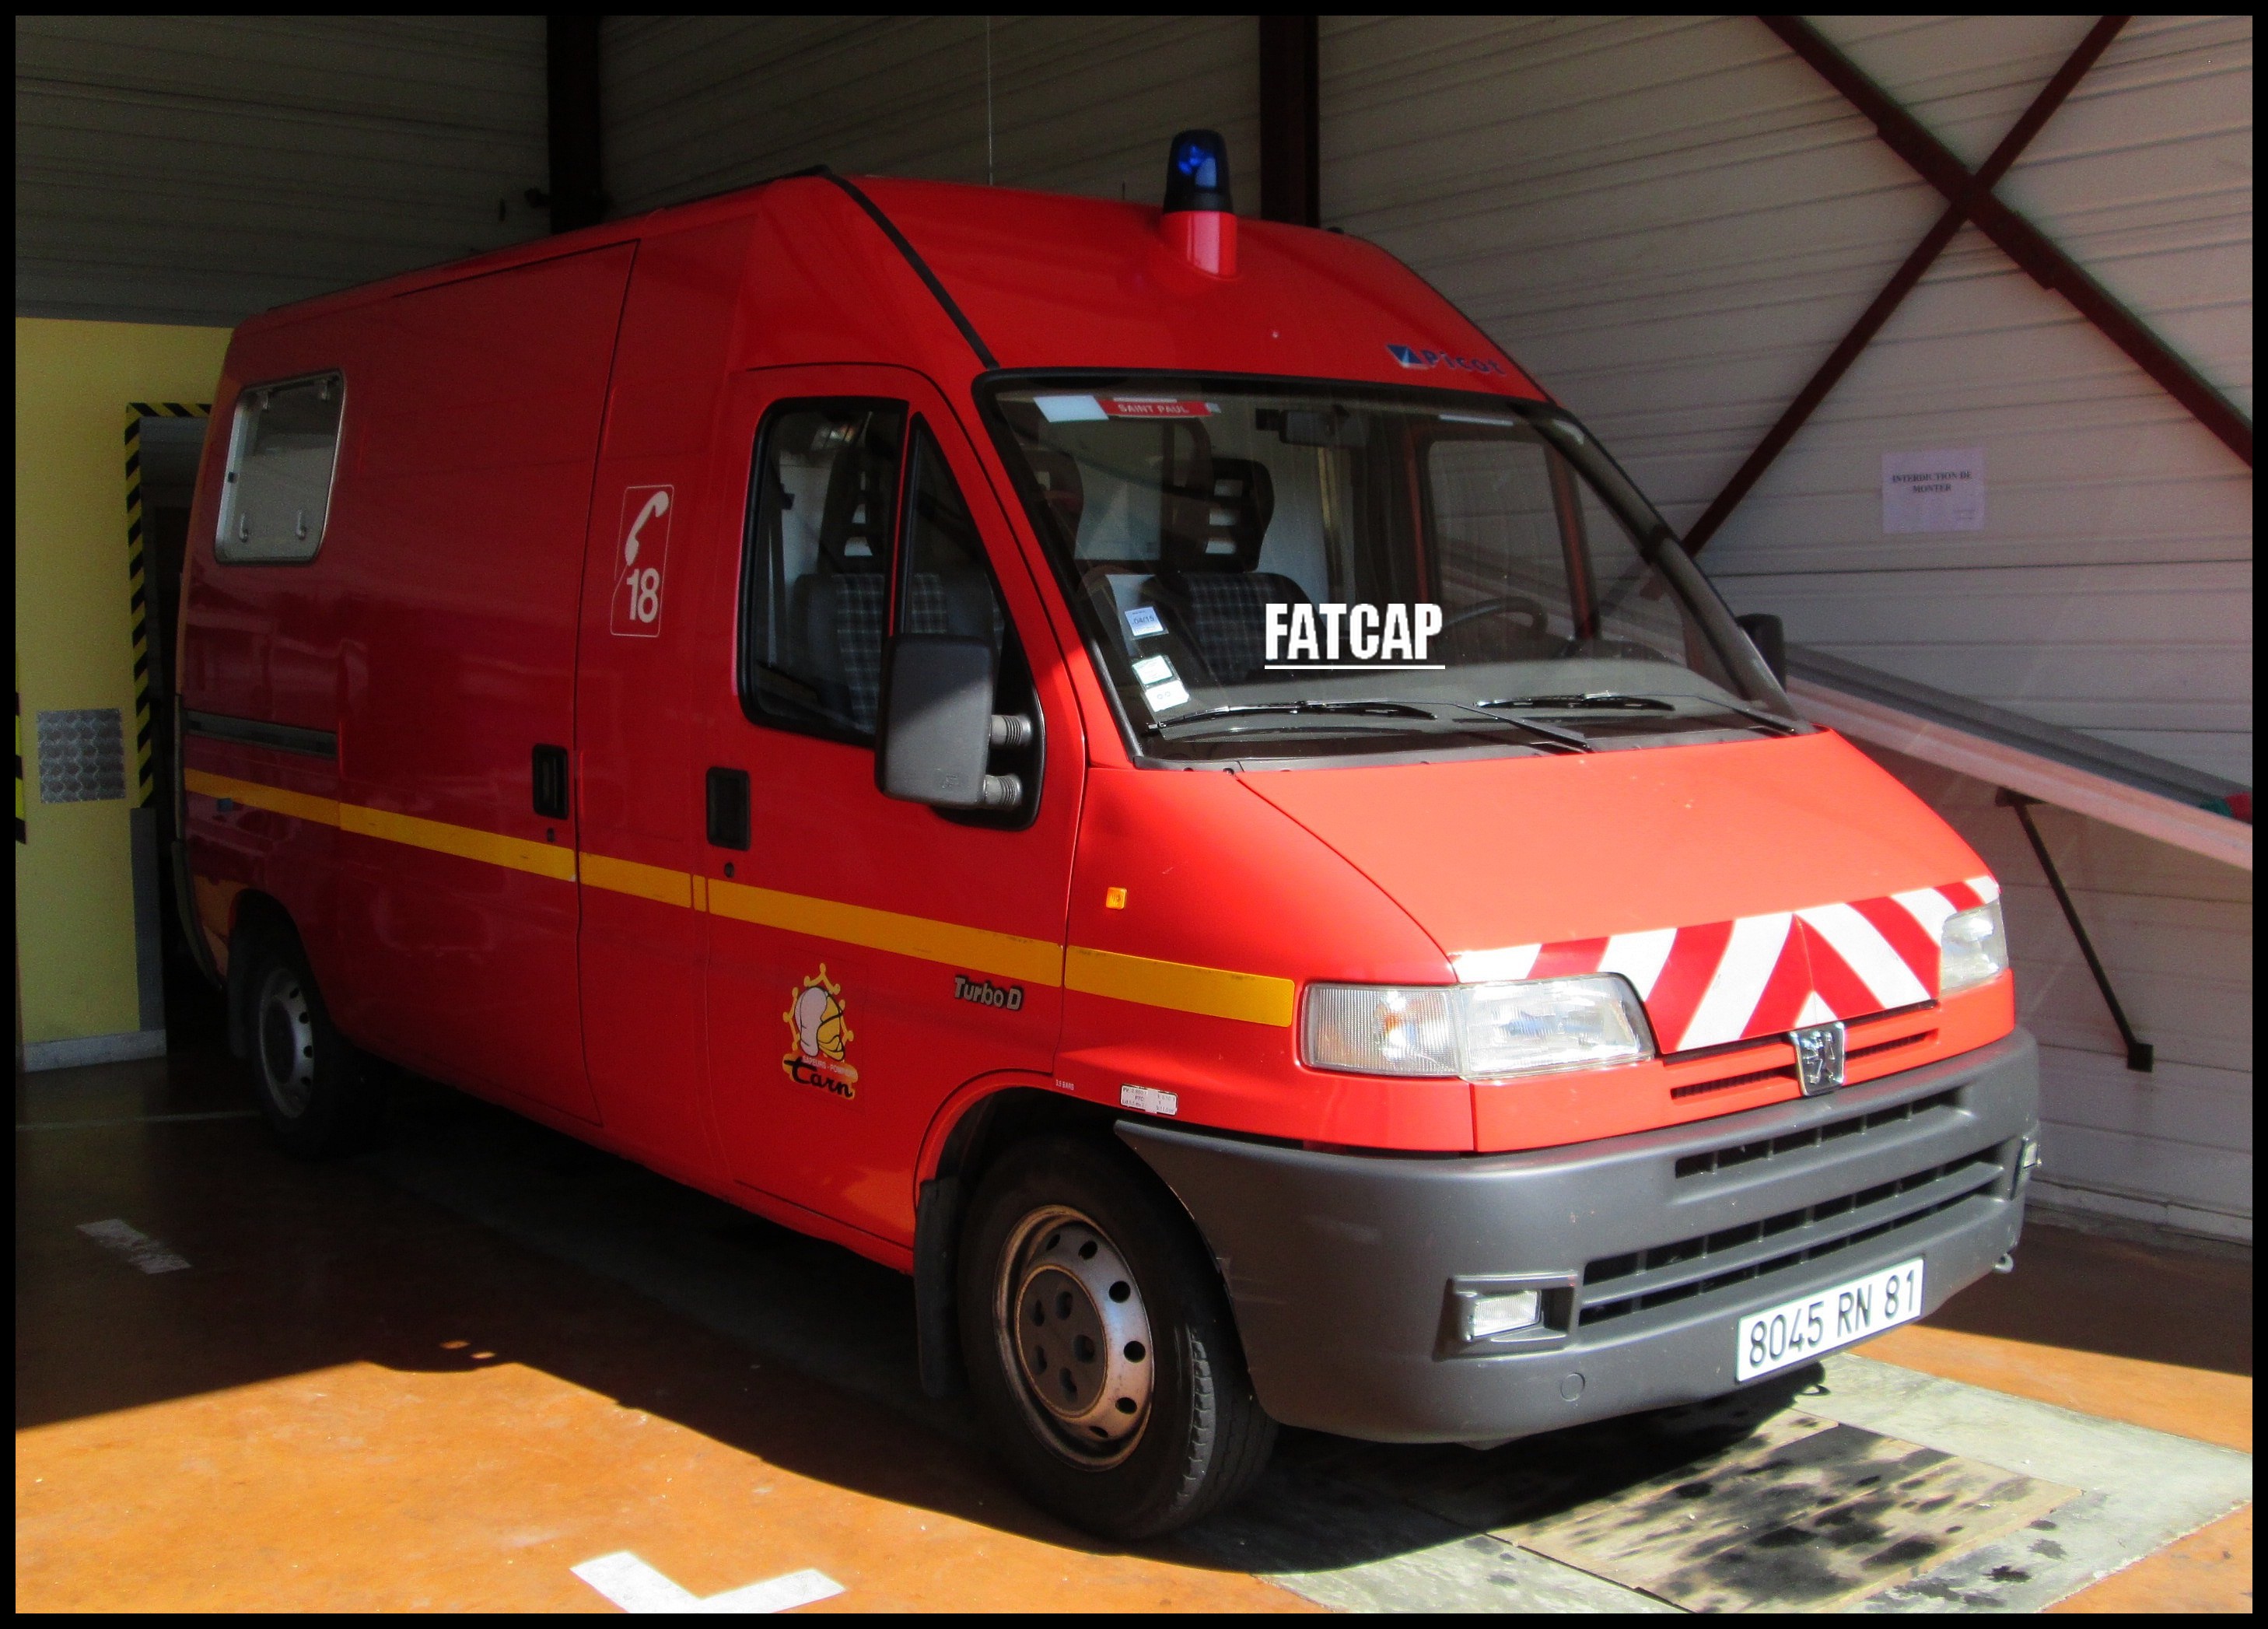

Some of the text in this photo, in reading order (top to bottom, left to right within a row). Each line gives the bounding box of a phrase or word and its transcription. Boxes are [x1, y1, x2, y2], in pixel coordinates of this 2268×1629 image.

[1420, 349, 1507, 376] Picot
[1118, 404, 1189, 415] SAINT PAUL
[1892, 471, 1972, 483] INTERDICTION DE
[1913, 484, 1951, 493] MONTER
[626, 567, 660, 624] 18
[954, 975, 1024, 1011] Turbo D
[1749, 1269, 1915, 1369] 8045 RN 81
